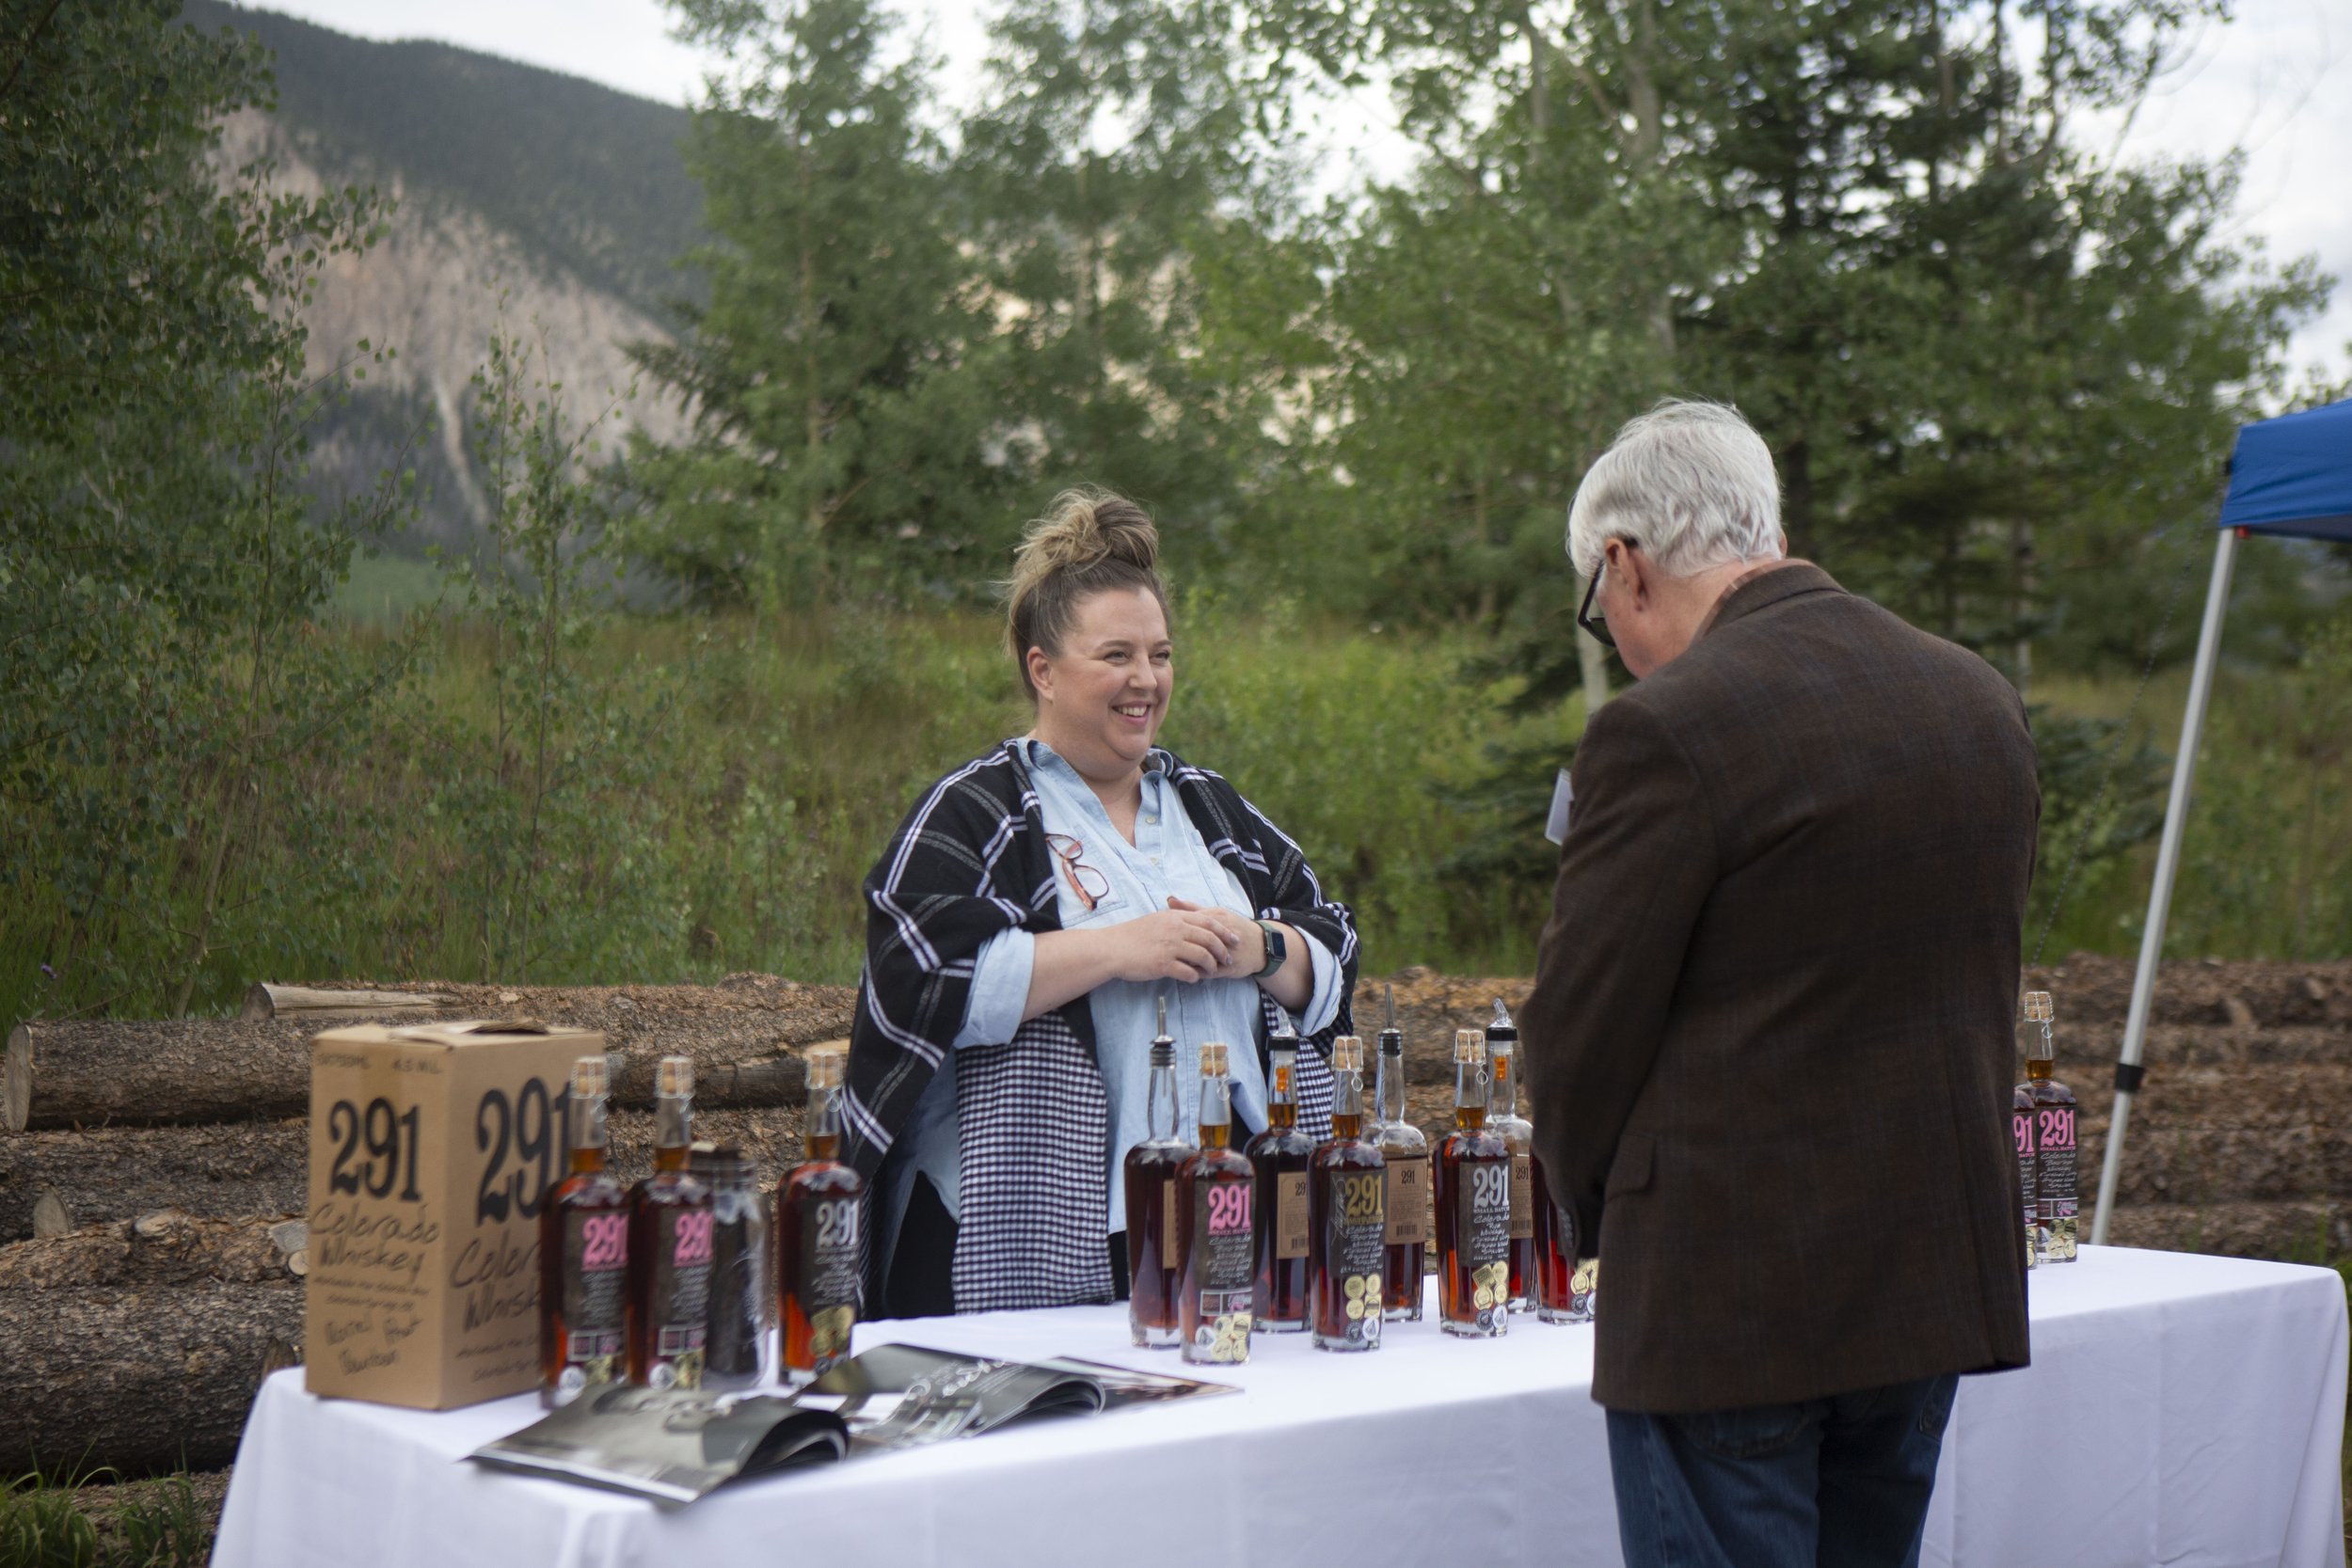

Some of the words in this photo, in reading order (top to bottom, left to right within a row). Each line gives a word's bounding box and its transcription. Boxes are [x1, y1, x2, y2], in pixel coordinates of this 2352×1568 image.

[329, 1097, 422, 1203] 291
[2013, 1115, 2034, 1153] 91
[2039, 1109, 2075, 1147] 291
[1295, 1180, 1307, 1196] 29
[1401, 1169, 1415, 1184] 291
[1473, 1164, 1510, 1209] 291
[1516, 1165, 1529, 1180] 291
[1208, 1183, 1251, 1231] 291
[1344, 1174, 1383, 1218] 291
[310, 1202, 440, 1244] Colorado
[582, 1212, 629, 1267] 291
[674, 1209, 714, 1263] 291
[816, 1199, 860, 1249] 291
[318, 1234, 425, 1285] Whiskey
[452, 1228, 542, 1290] Color
